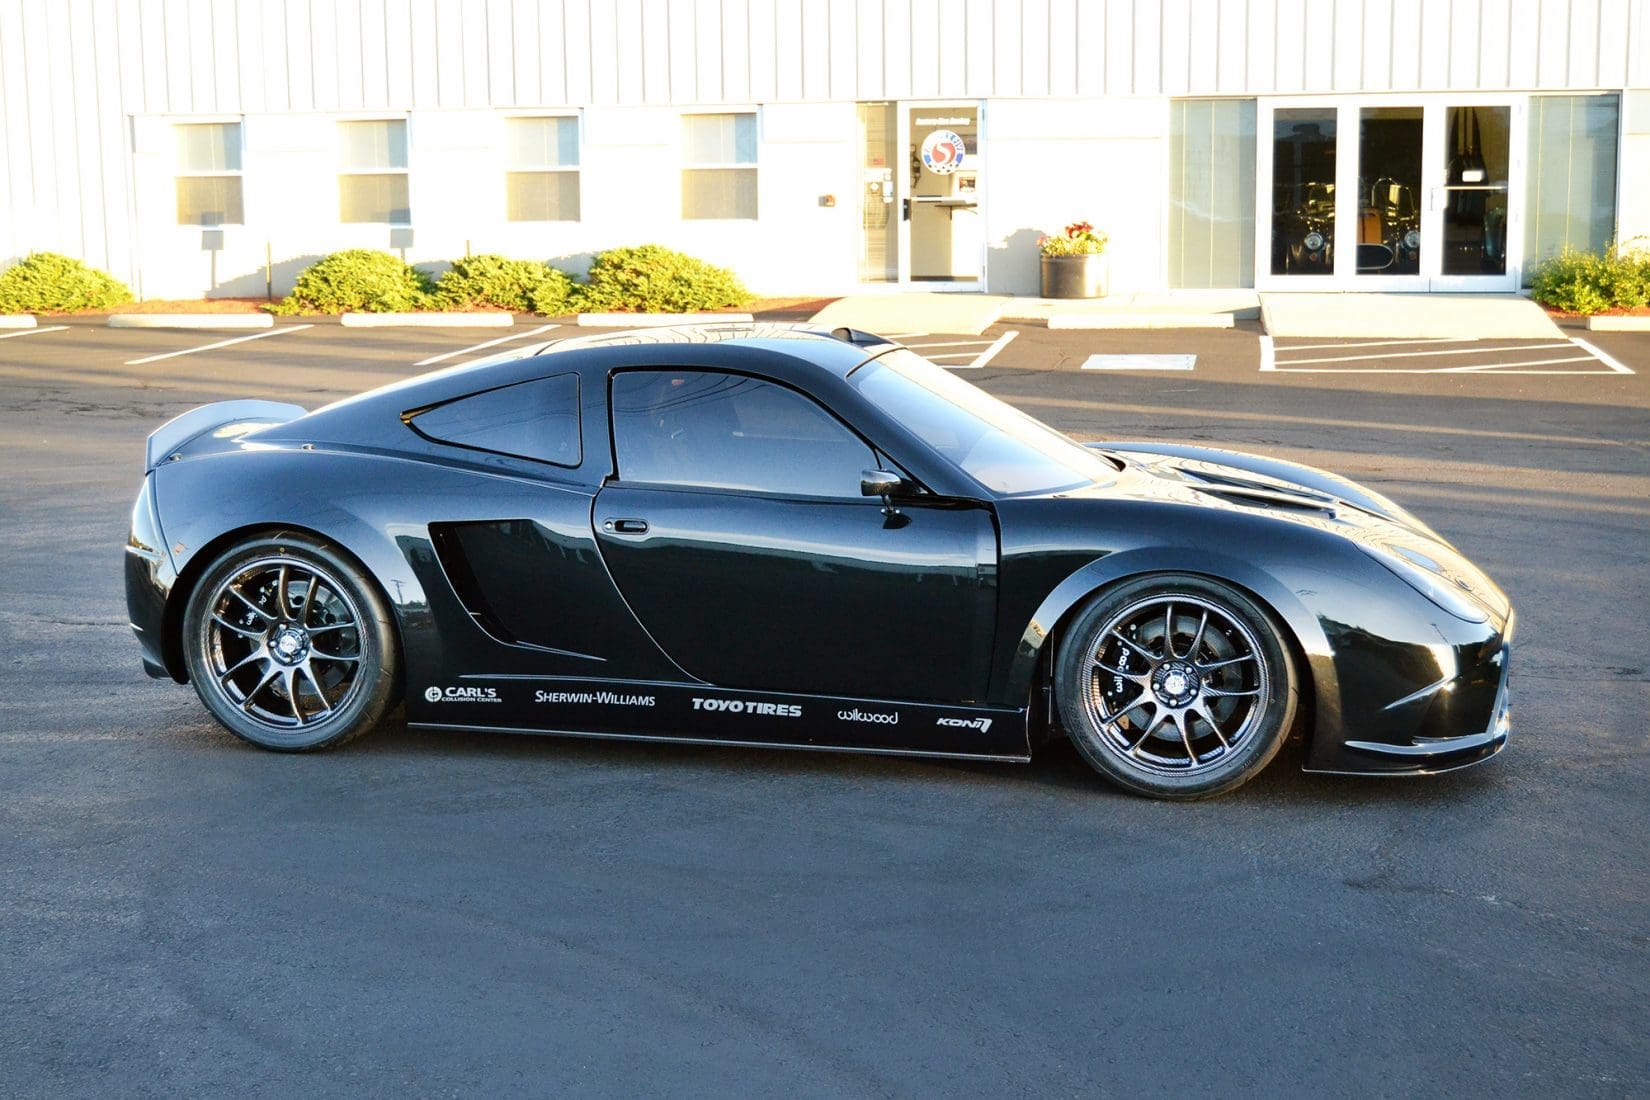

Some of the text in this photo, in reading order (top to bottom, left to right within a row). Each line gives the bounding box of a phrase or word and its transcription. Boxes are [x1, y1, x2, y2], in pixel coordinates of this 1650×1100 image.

[445, 687, 497, 698] CARL'S
[535, 690, 656, 706] SHERWIN-WILLIAMS
[692, 698, 802, 717] TOYO TIRES
[837, 708, 898, 725] wilwood
